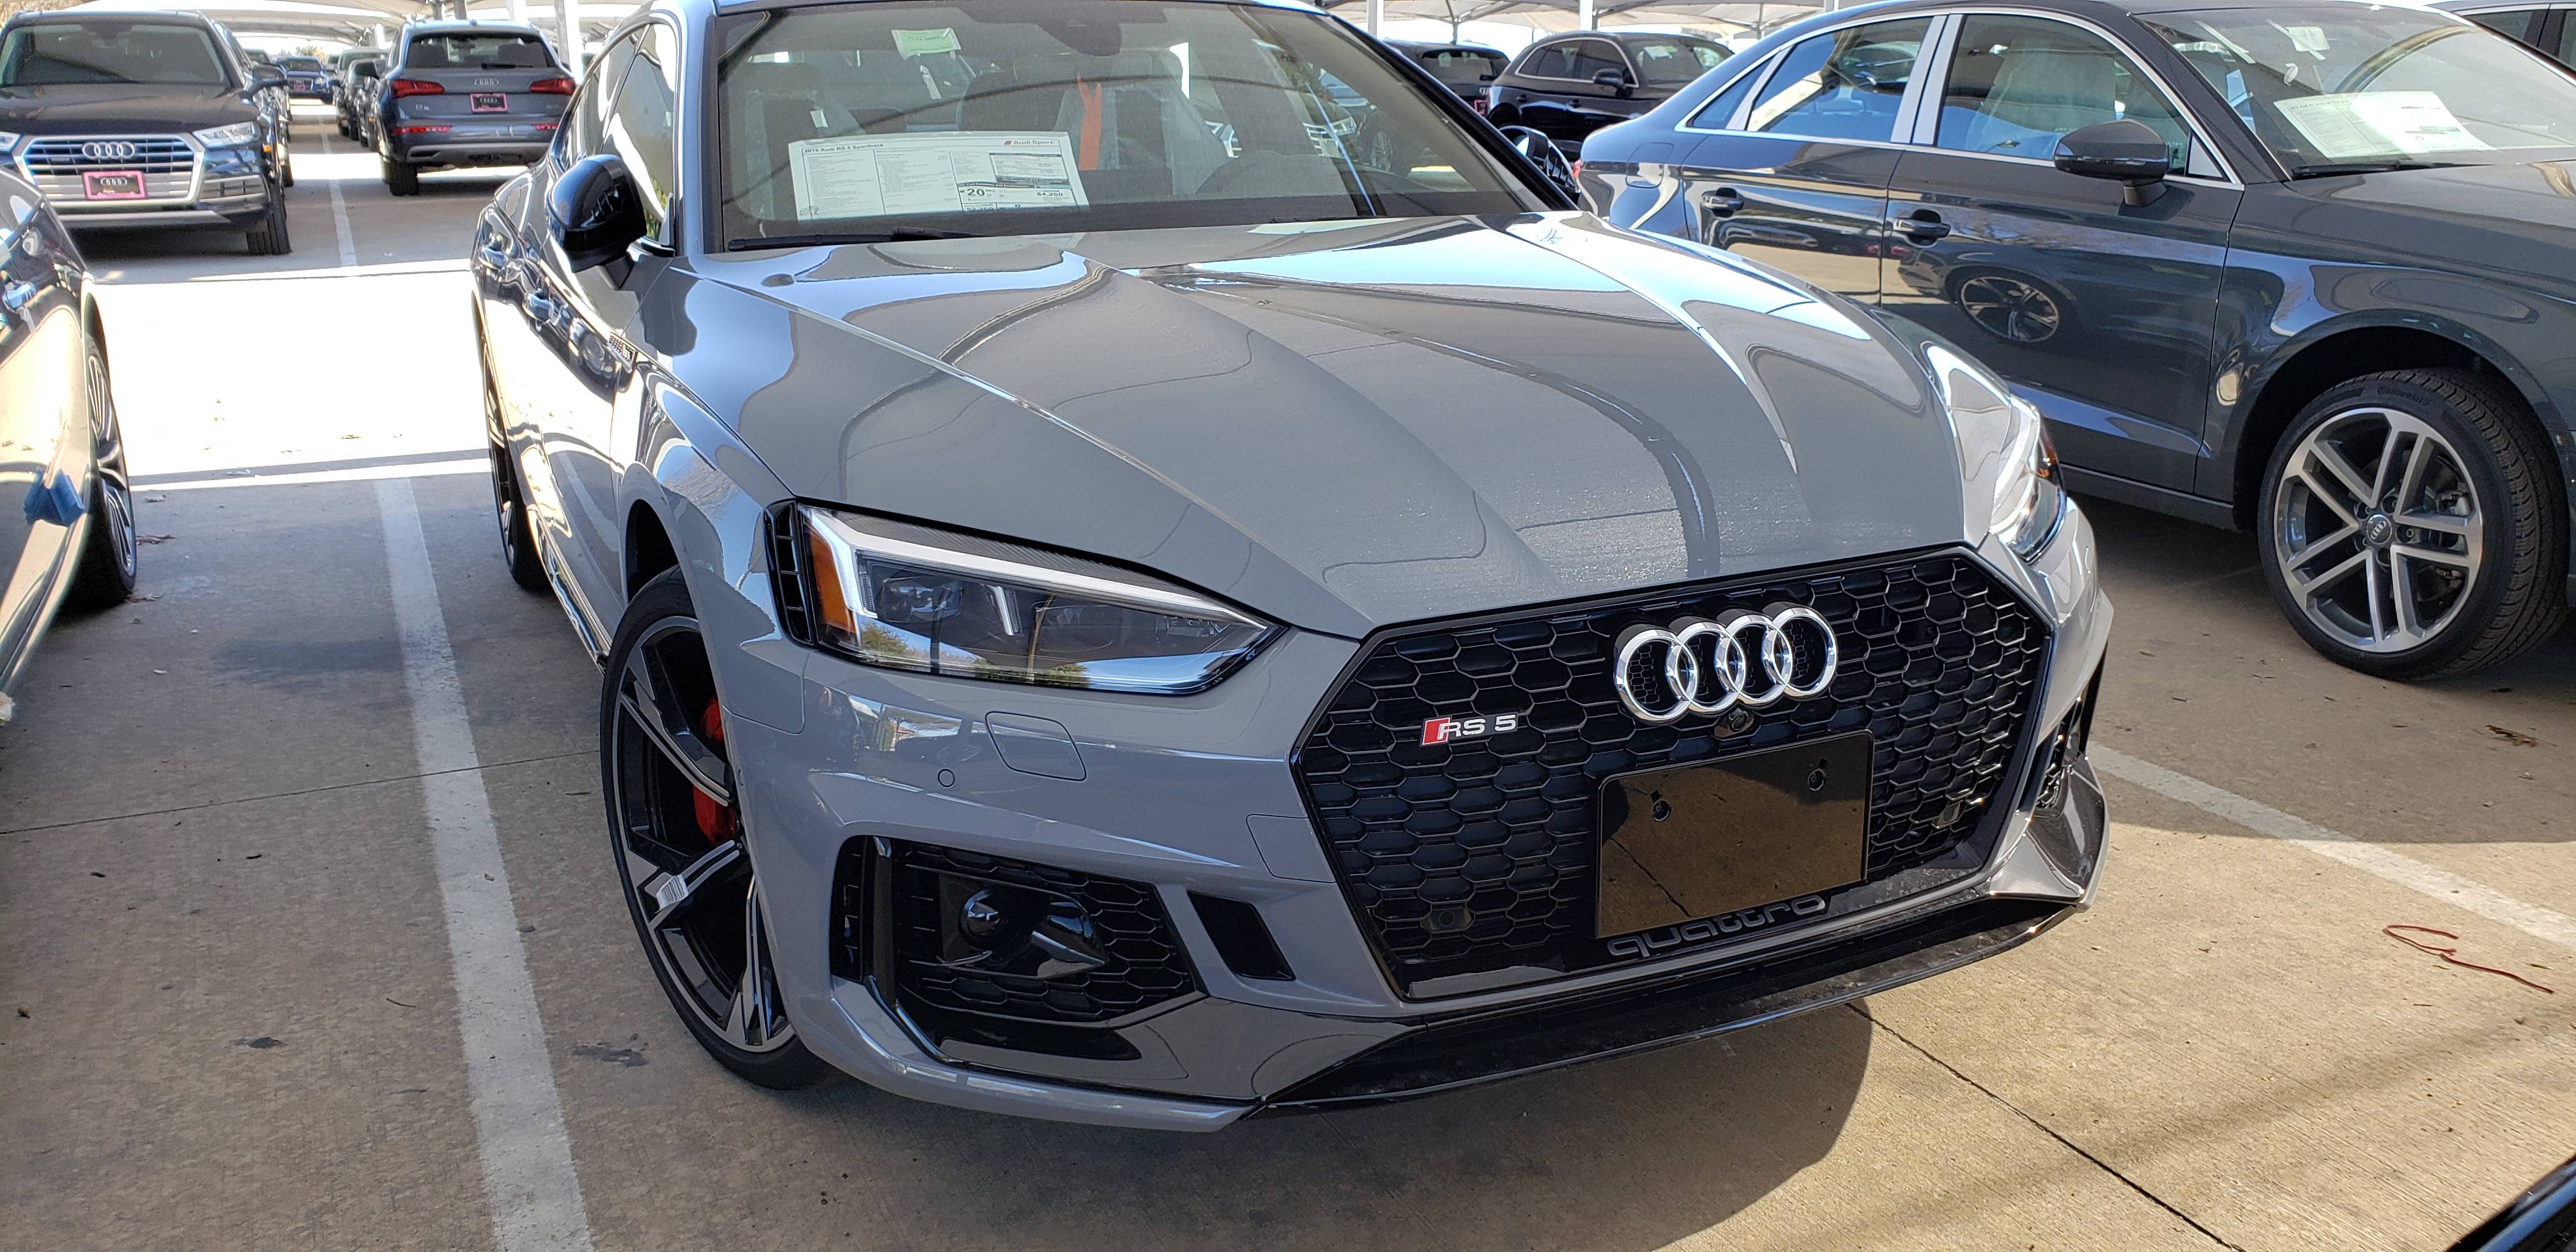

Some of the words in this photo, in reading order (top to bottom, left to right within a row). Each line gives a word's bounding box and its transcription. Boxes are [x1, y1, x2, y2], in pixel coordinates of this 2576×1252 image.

[1436, 718, 1486, 740] RS
[1494, 714, 1516, 732] 5
[1606, 894, 1827, 958] quattro
